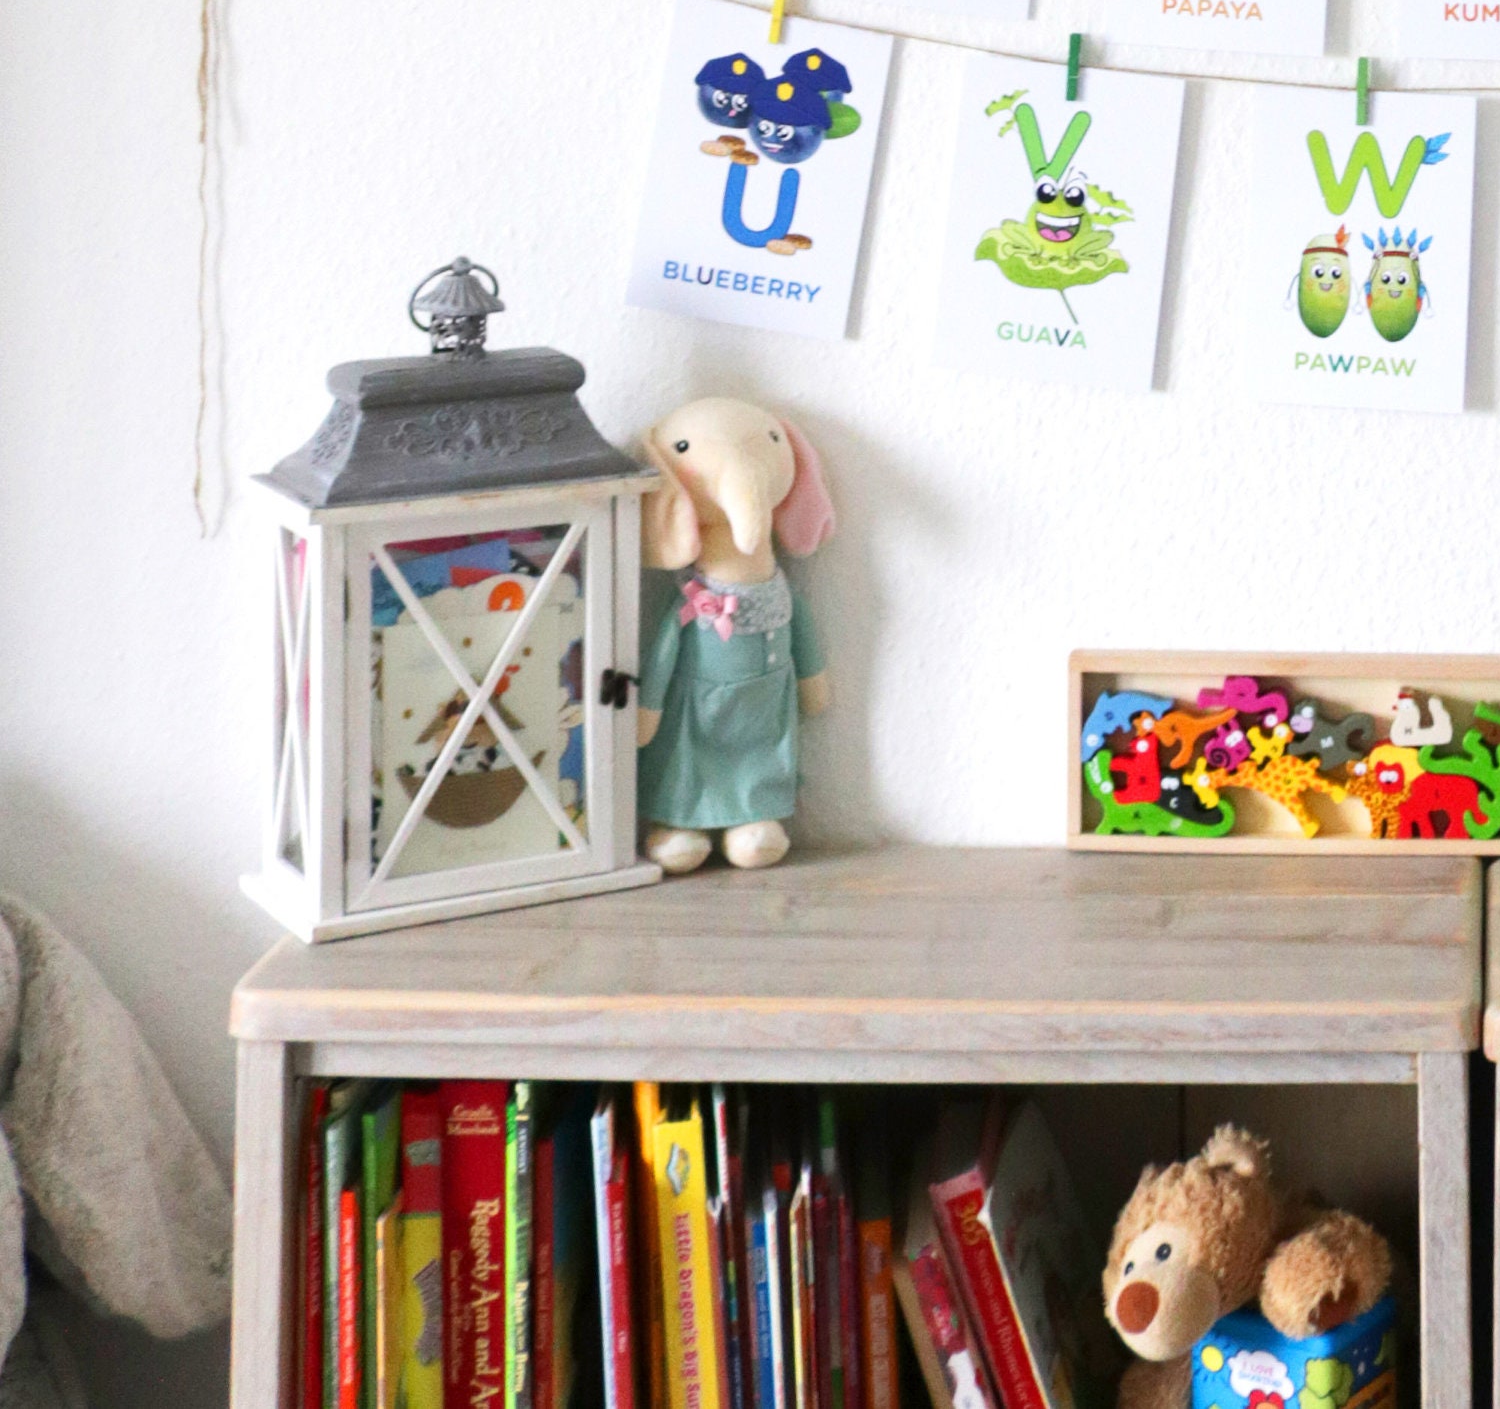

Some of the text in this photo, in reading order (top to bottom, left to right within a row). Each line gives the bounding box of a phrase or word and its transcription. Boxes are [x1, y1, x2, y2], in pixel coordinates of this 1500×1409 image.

[1014, 102, 1092, 182] V
[1307, 129, 1427, 219] W
[722, 161, 801, 248] U
[662, 259, 822, 304] BLUEBERRY
[996, 320, 1089, 350] GUAVA
[1294, 351, 1417, 378] PAWPAW
[470, 1198, 500, 1282] Raggedy
[674, 1213, 691, 1262] Little
[470, 1284, 500, 1332] Ann
[678, 1269, 697, 1345] Dragon's
[474, 1338, 500, 1376] and
